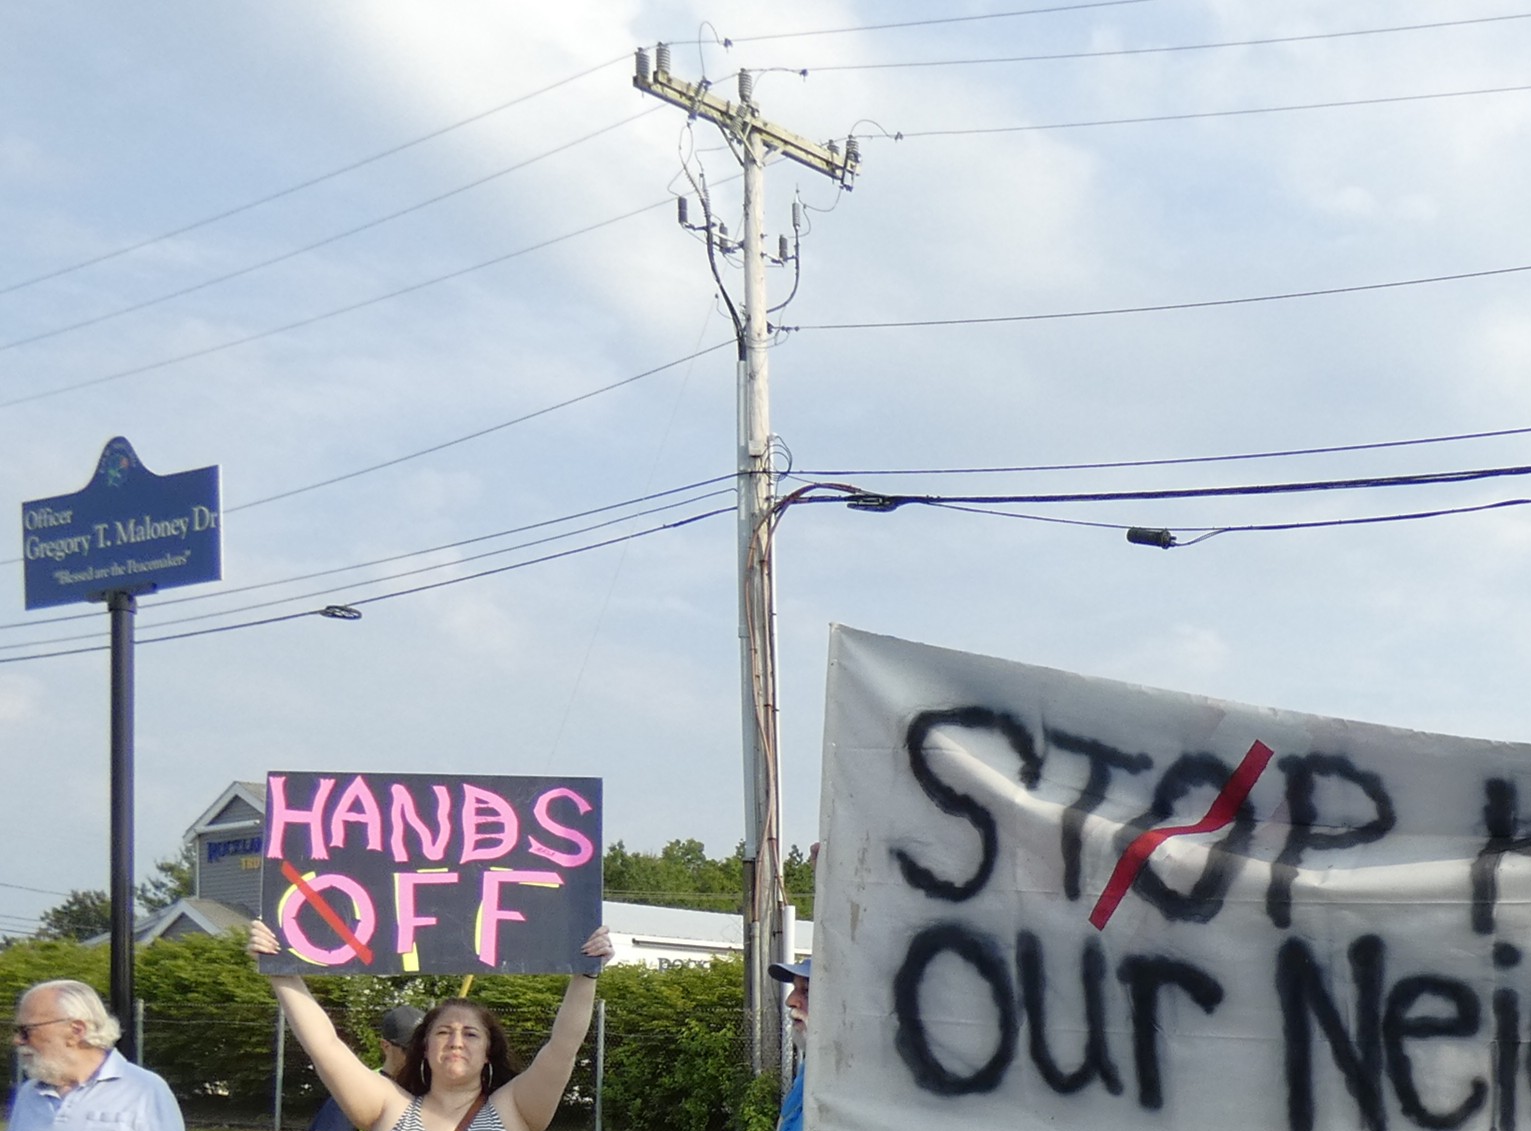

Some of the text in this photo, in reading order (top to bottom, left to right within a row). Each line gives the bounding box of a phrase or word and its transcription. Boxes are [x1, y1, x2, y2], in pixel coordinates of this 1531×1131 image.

[25, 507, 73, 530] Officer
[26, 505, 218, 561] Gregory T. Maloney Dr
[94, 568, 109, 579] are
[111, 561, 126, 576] the
[266, 775, 594, 868] HANDS
[888, 704, 1396, 928] STOP
[278, 862, 565, 970] OFF
